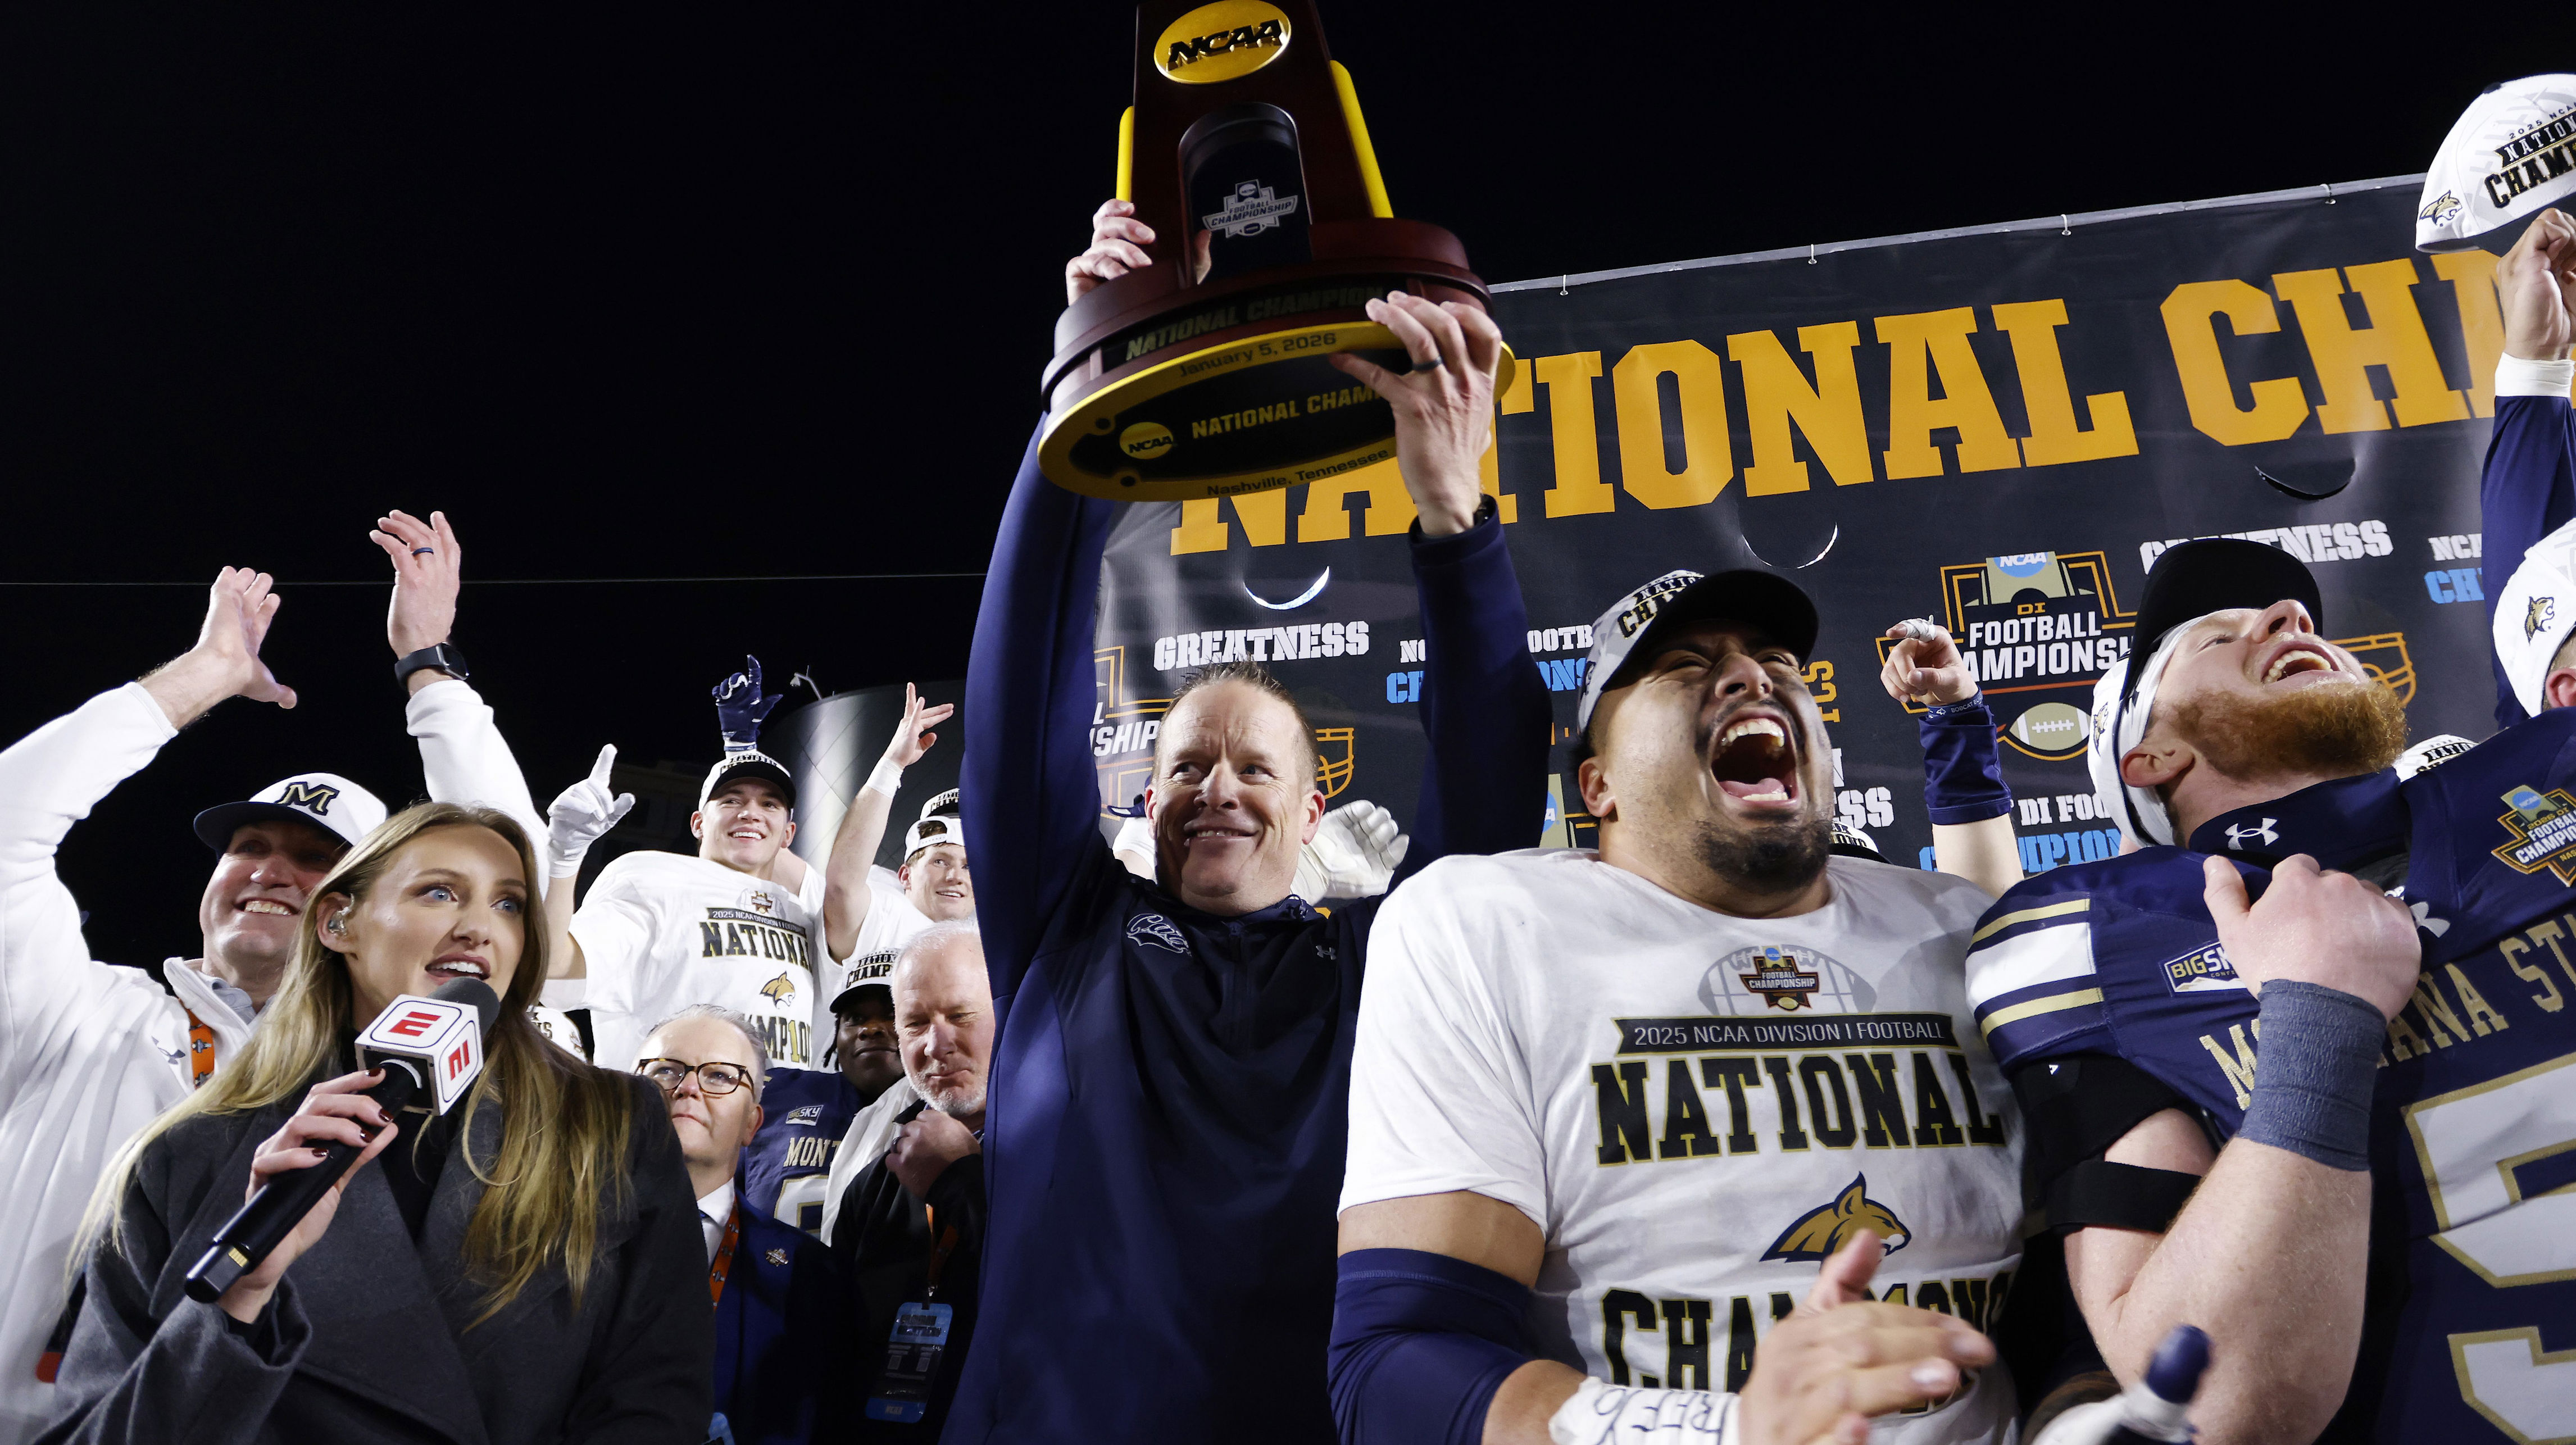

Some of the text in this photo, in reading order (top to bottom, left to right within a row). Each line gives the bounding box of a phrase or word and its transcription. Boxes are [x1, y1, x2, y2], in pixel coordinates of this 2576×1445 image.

[1166, 19, 1285, 70] NCAA
[2509, 102, 2576, 139] 2025 NCA
[1211, 201, 1291, 226] CHAMPIONSHIP
[1229, 201, 1269, 213] FOOTBALL
[1126, 306, 1238, 361] NATIONAL
[1180, 332, 1337, 378] January 5, 2026
[1192, 385, 1382, 440] NATIONAL CHAM
[1128, 436, 1173, 453] NCAA
[1207, 449, 1389, 496] Nashville, Tennessee
[1998, 551, 2047, 568] NCAA
[2017, 602, 2046, 616] DI
[1153, 620, 1370, 671] GREATNESS
[1969, 611, 2102, 648] FOOTBALL
[1951, 701, 1974, 713] BOBCAT
[273, 781, 340, 816] M
[2018, 797, 2053, 826] DI
[1748, 978, 1815, 989] CHAMPIONSHIP
[1634, 1026, 1687, 1046] 2025
[1693, 1025, 1748, 1044] NCAA
[1755, 1023, 1840, 1043] DIVISION
[1856, 1020, 1945, 1040] FOOTBALL
[1590, 1052, 2007, 1167] NATIONAL
